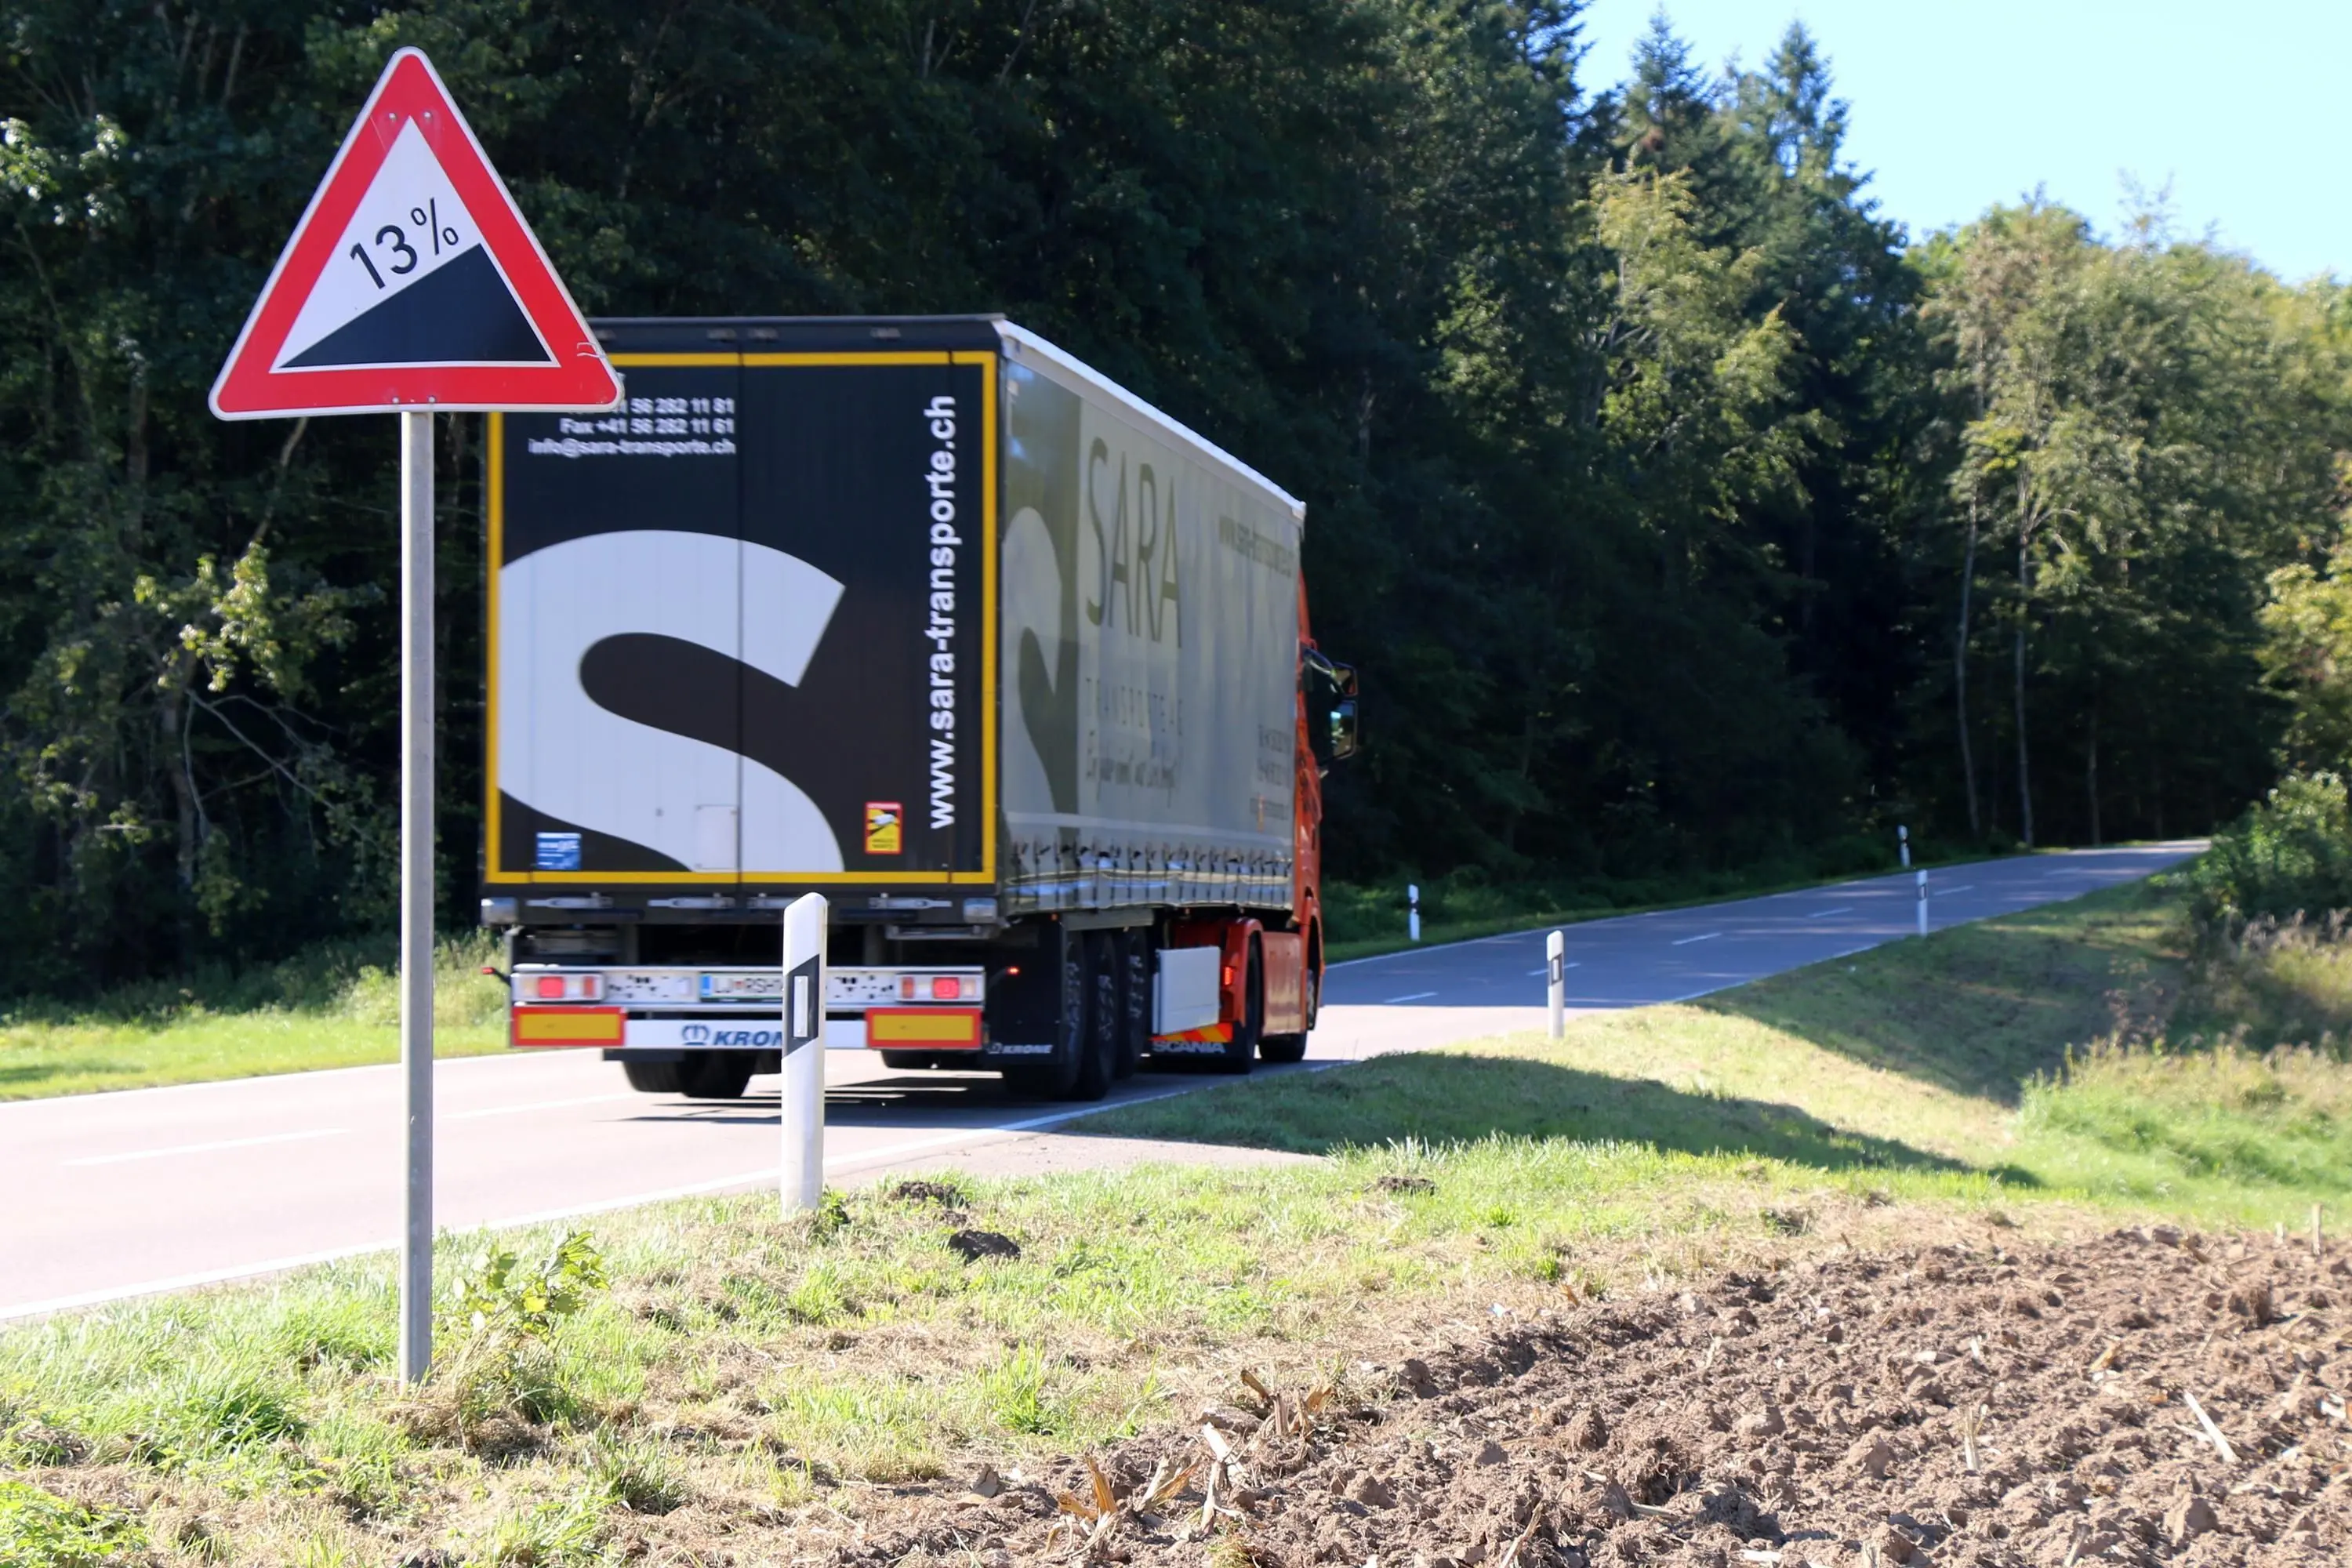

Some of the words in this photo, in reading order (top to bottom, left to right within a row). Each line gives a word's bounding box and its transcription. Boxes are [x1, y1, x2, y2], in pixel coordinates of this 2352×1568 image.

[350, 197, 459, 289] 13%
[690, 397, 710, 414] 11
[560, 418, 593, 434] Fax
[690, 418, 710, 434] 11
[1086, 436, 1181, 649] SARA
[923, 396, 962, 830] www.sara-transporte.ch
[713, 1030, 782, 1046] KRON
[1002, 1044, 1054, 1054] KRONE
[1152, 1040, 1226, 1054] SCANIA
